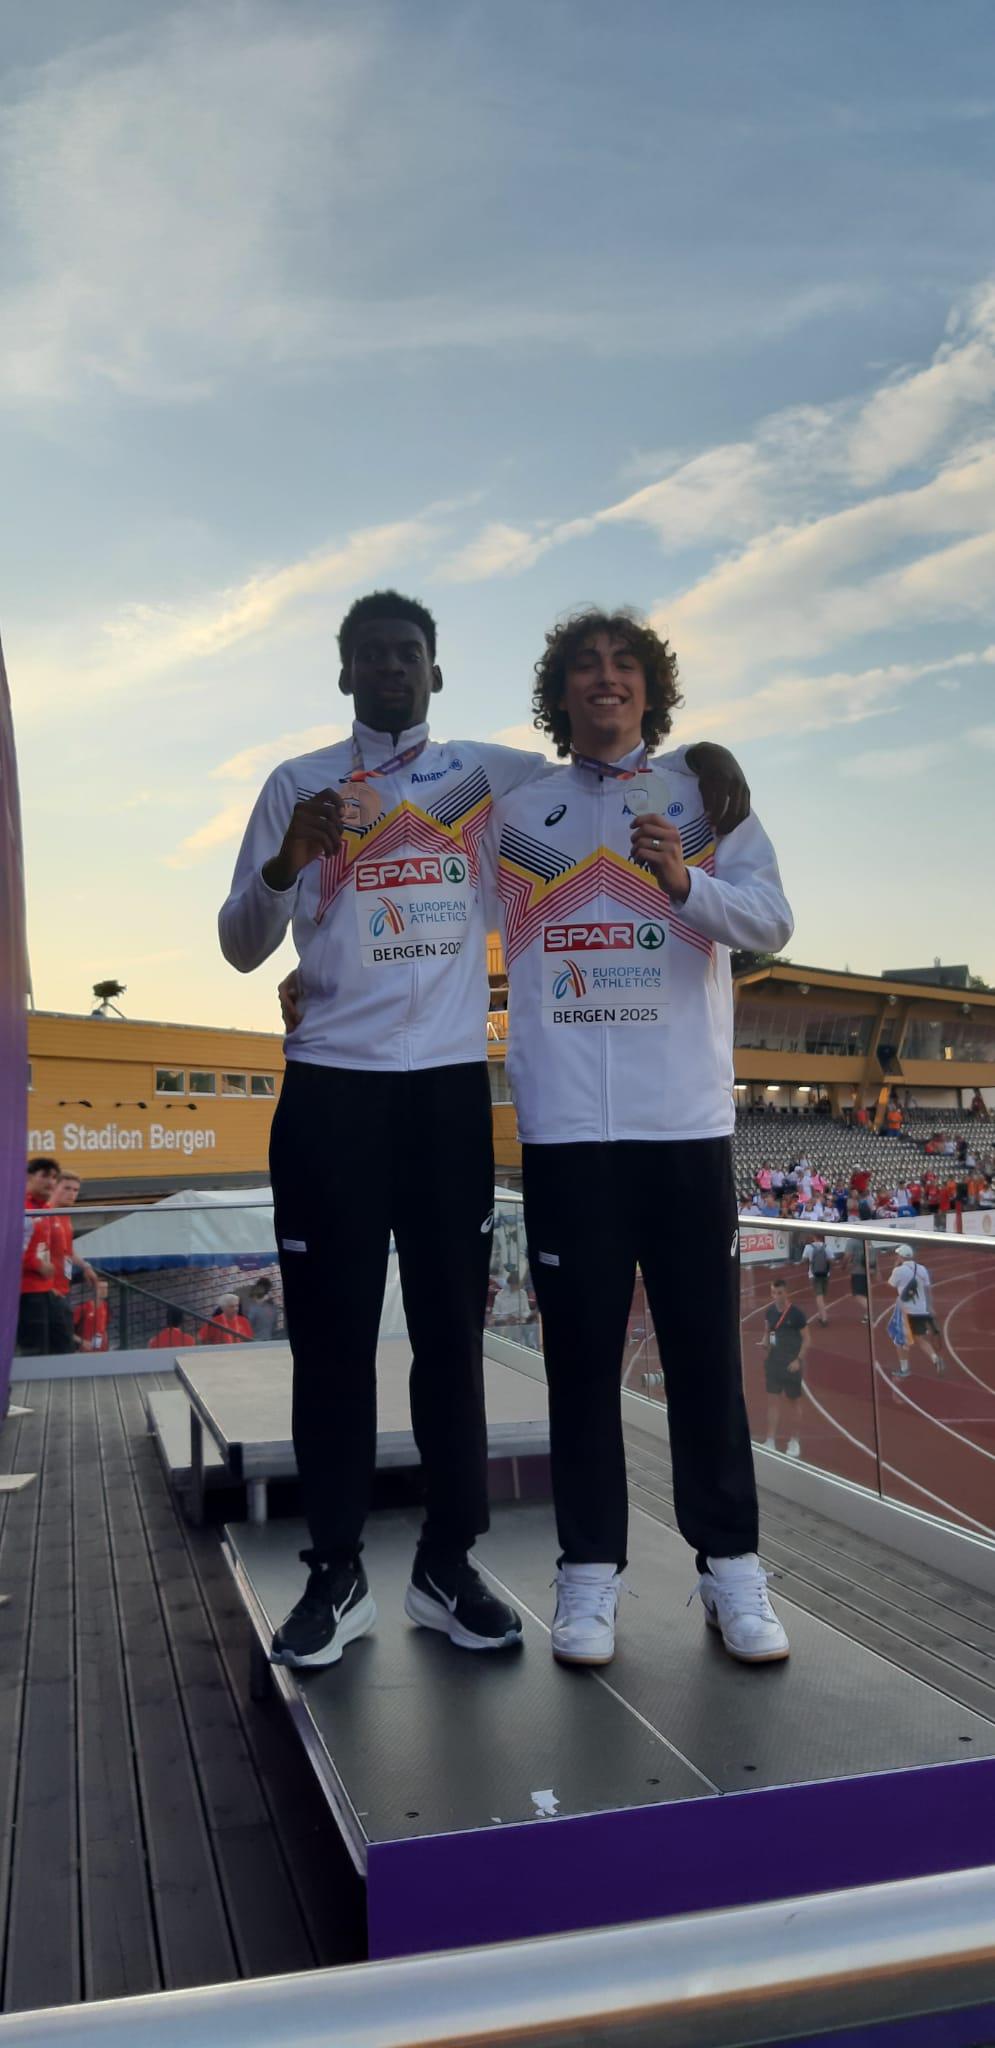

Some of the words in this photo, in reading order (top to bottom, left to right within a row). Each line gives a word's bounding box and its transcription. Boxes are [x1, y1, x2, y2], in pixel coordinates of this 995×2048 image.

[358, 860, 440, 888] SPAR
[409, 900, 466, 913] EUROPEAN
[410, 911, 467, 924] ATHLETICS
[546, 926, 632, 948] SPAR
[373, 943, 436, 962] BERGEN
[440, 941, 463, 955] 202
[592, 967, 661, 977] EUROPEAN
[592, 977, 661, 989] ATHLETICS
[553, 1008, 615, 1023] BERGEN
[620, 1008, 658, 1021] 2025
[27, 1128, 56, 1151] na
[63, 1122, 143, 1150] Stadion
[150, 1123, 216, 1155] Bergen
[739, 1236, 774, 1250] SPAR
